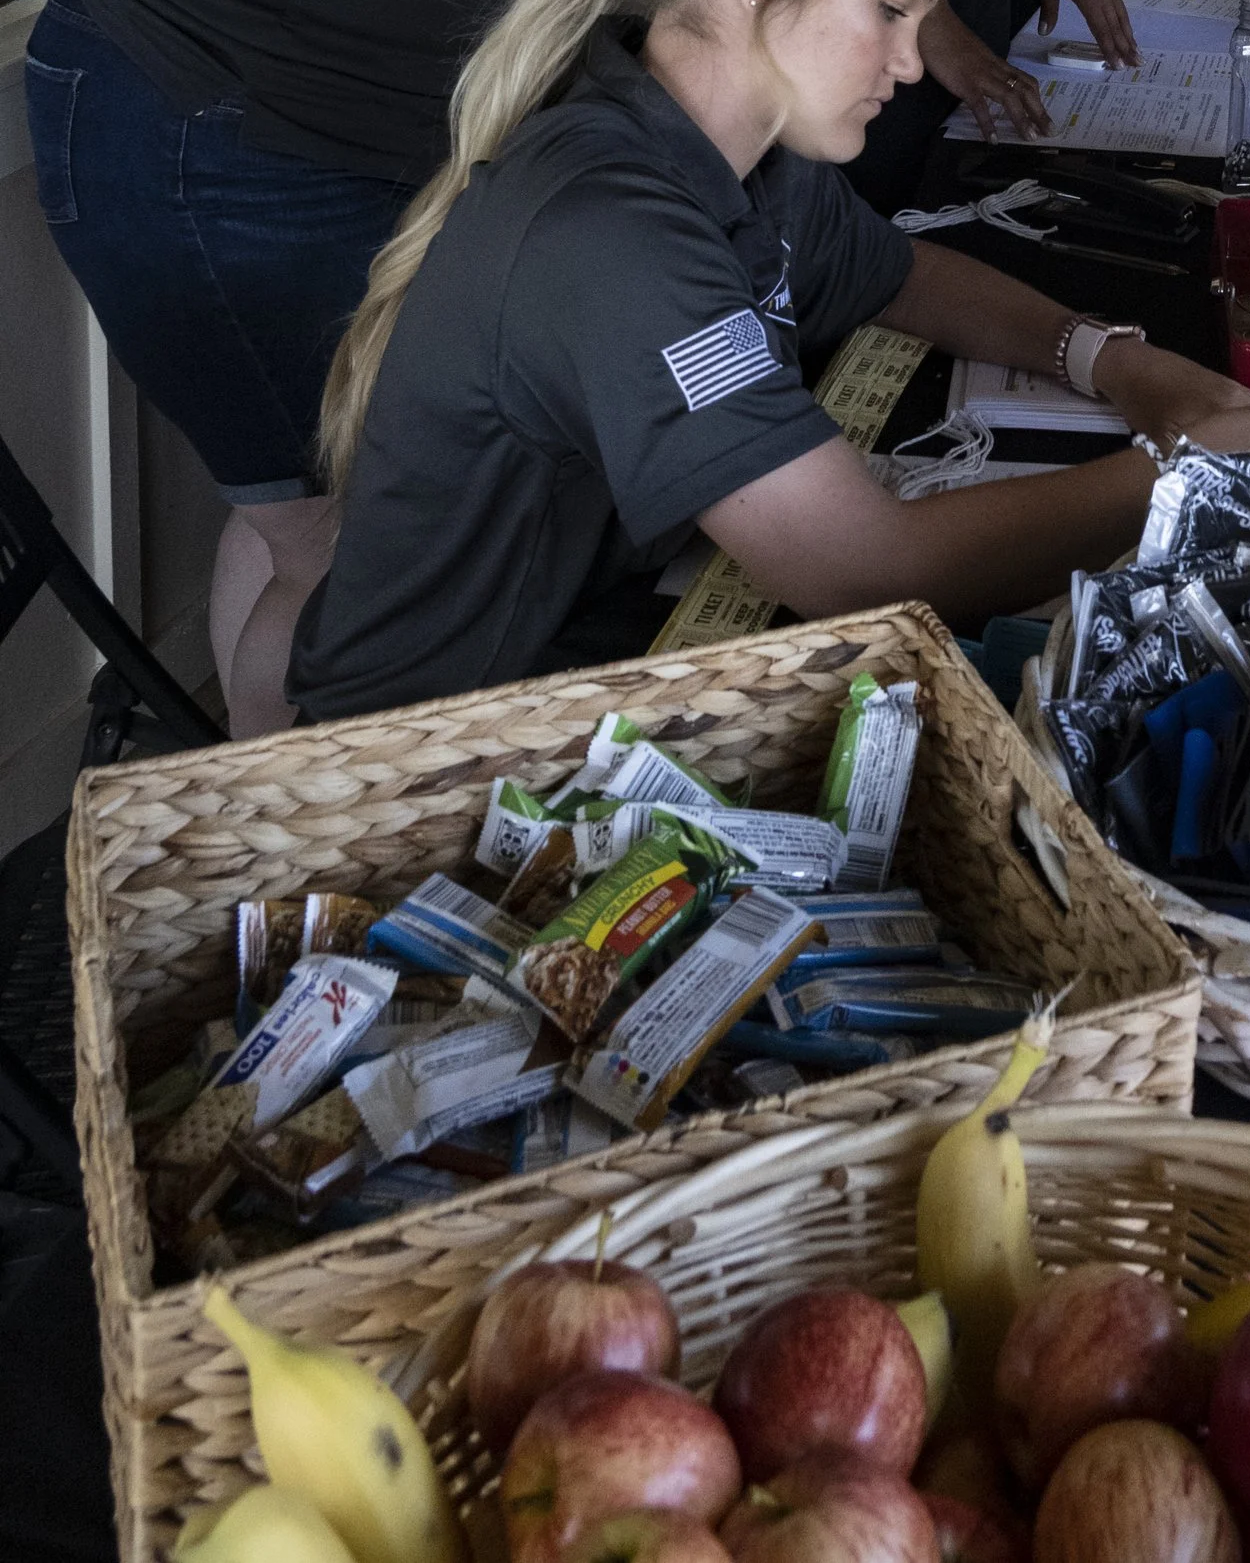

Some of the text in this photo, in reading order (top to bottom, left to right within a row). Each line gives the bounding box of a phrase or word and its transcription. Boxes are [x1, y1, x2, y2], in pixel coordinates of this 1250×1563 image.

[852, 357, 874, 376] TICKET
[833, 384, 856, 407] TICKET
[721, 558, 742, 578] TIC
[694, 591, 725, 625] TICKET
[732, 602, 749, 625] KEEP
[746, 599, 770, 633] COUPON
[600, 874, 657, 926] CRUNCHY
[236, 1035, 273, 1075] 100
